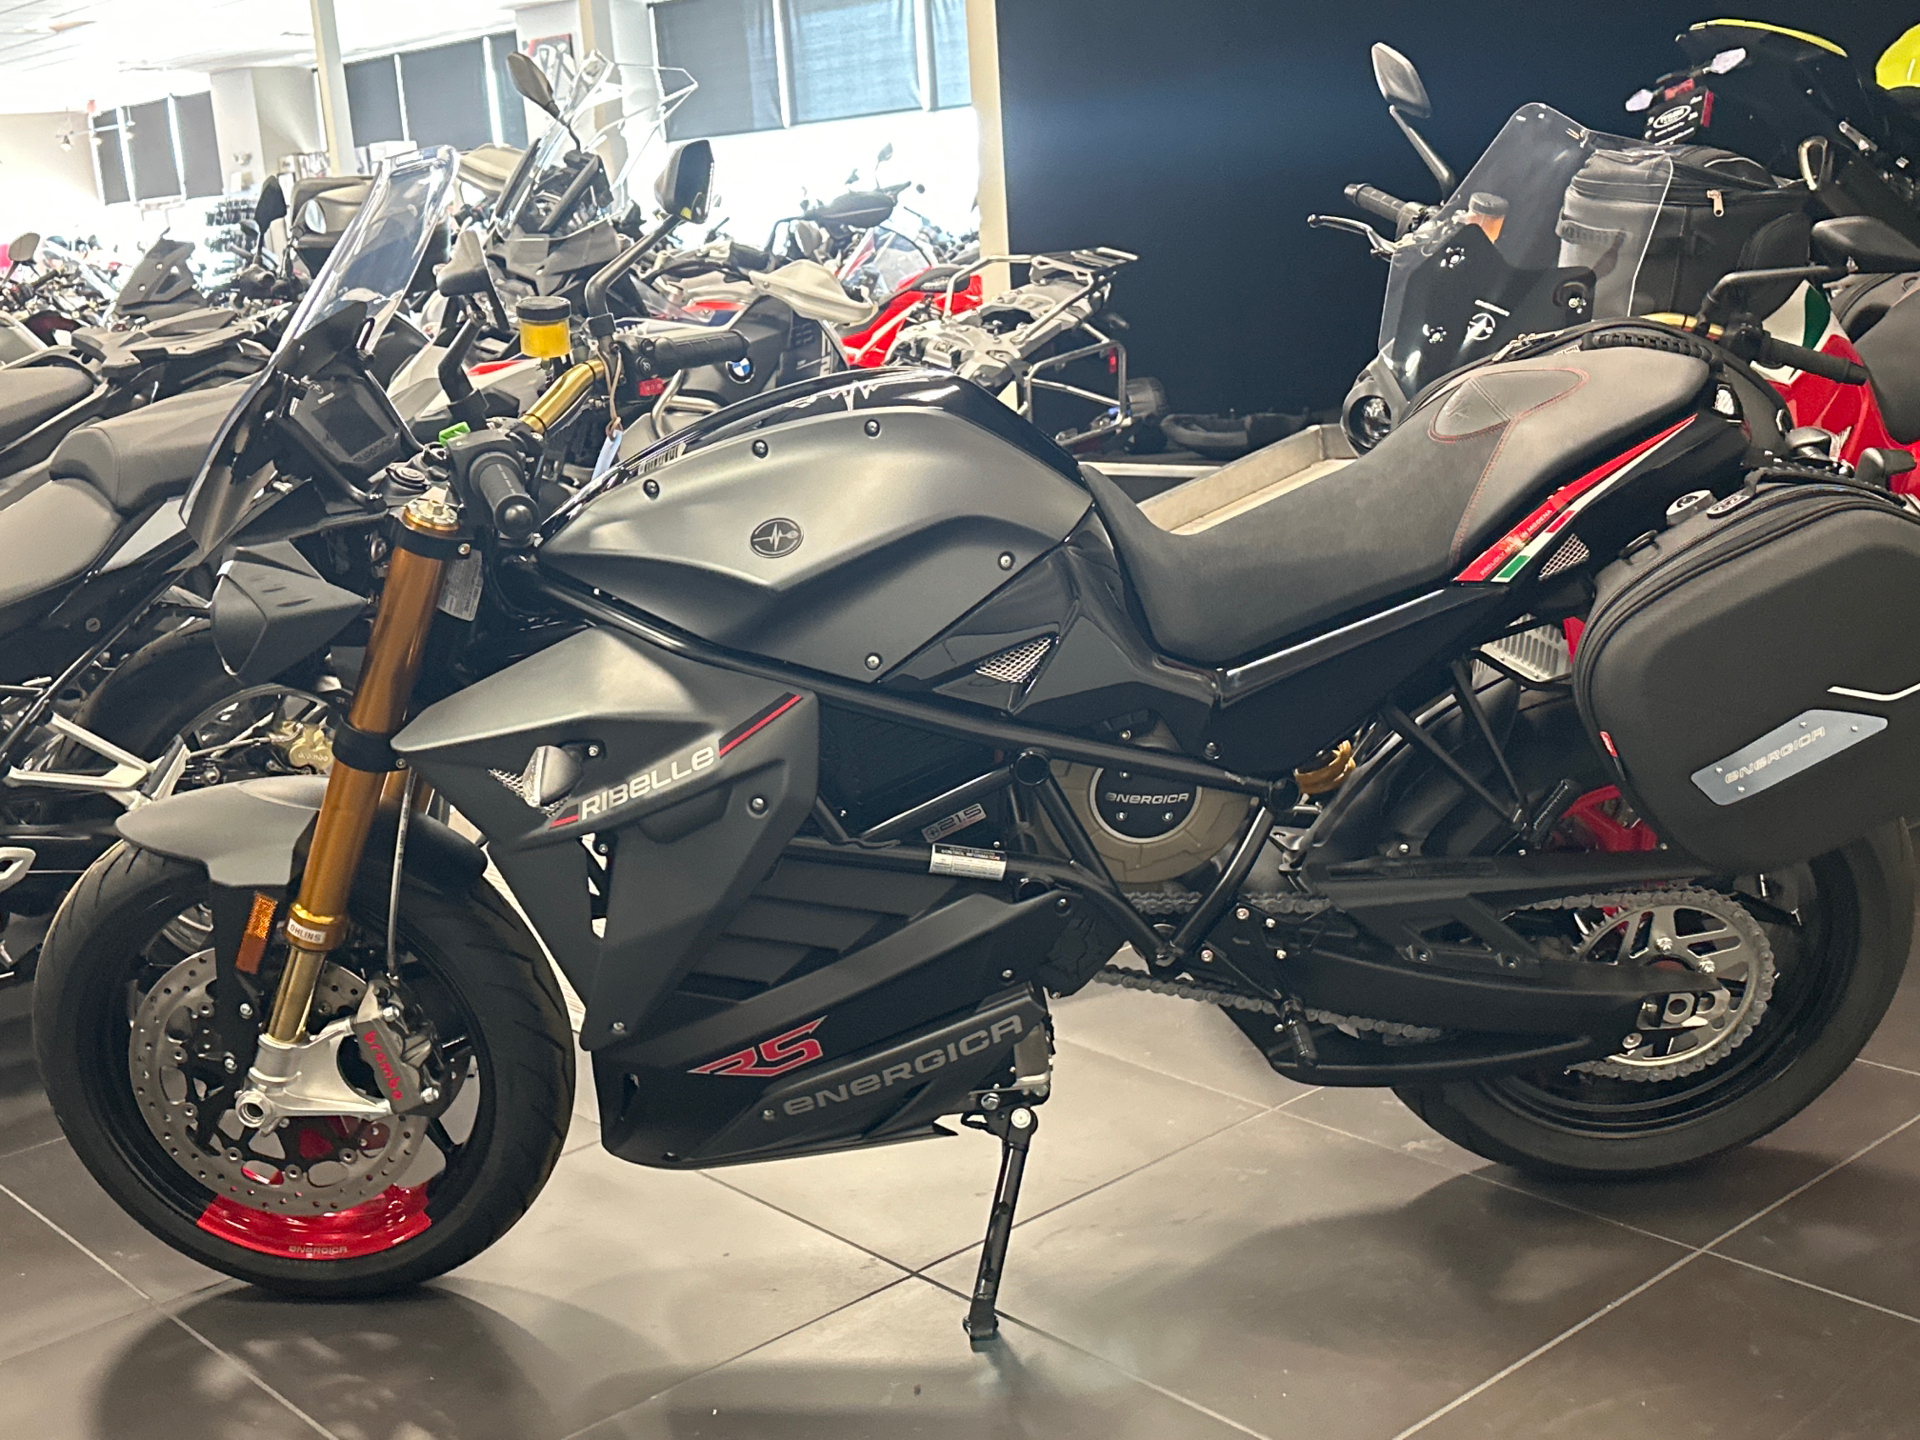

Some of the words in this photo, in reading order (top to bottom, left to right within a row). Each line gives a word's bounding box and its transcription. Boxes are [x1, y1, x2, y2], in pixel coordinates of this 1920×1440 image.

[1527, 509, 1553, 533] MODENA
[937, 804, 983, 832] 21.5
[364, 1030, 404, 1101] brembo
[686, 1015, 828, 1077] RS
